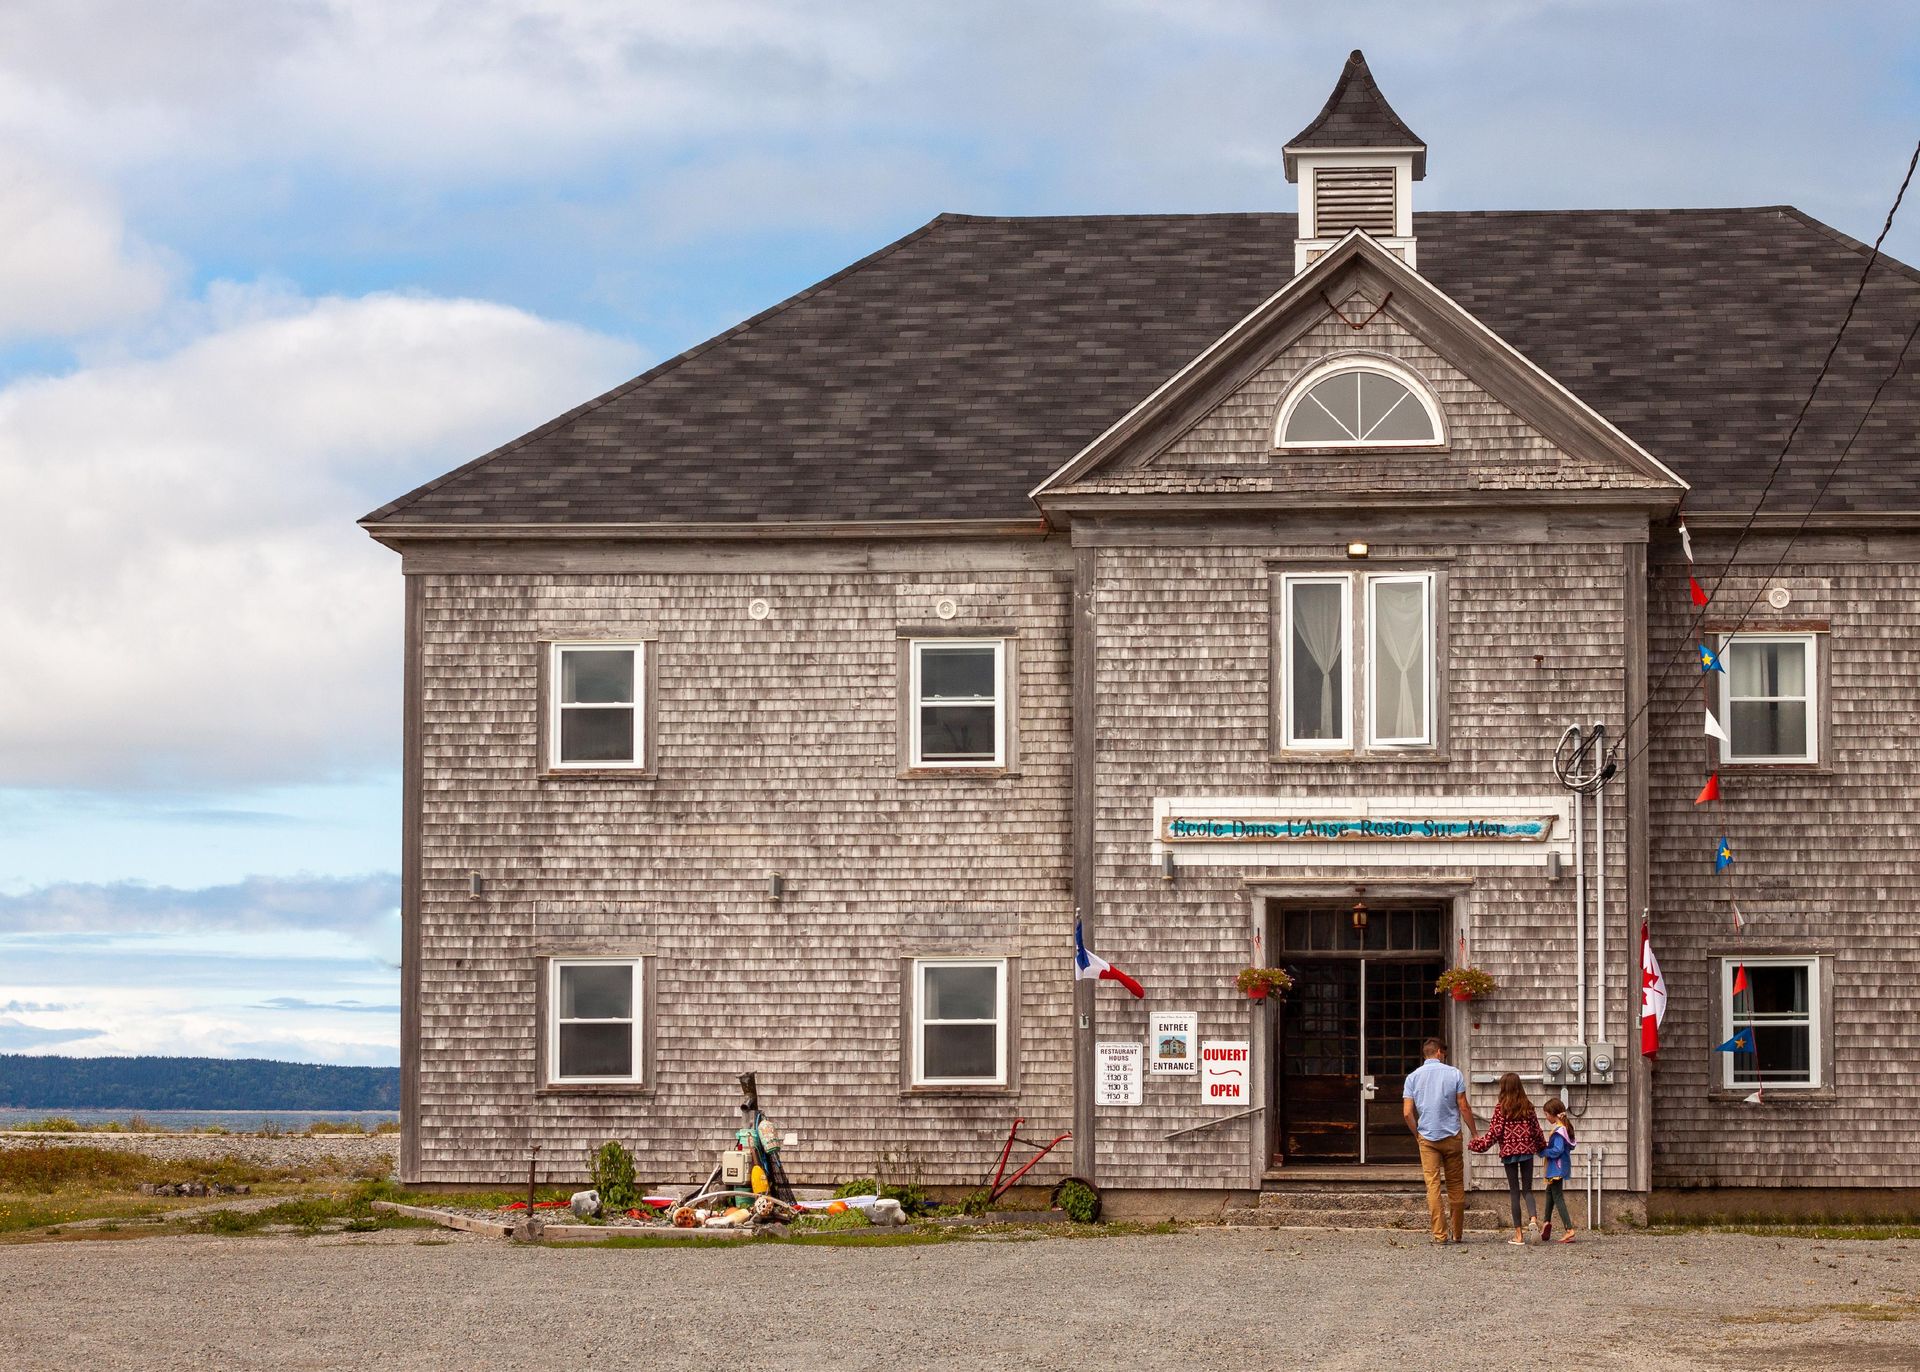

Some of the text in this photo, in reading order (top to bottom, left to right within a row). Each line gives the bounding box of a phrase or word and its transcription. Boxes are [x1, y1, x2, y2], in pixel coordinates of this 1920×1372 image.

[1173, 816, 1505, 838] École Dans L'Anse Resto Sur Mer
[1158, 1020, 1189, 1032] ENTRÉE
[1203, 1048, 1249, 1062] OUVERT
[1153, 1062, 1195, 1071] ENTRANCE
[1210, 1083, 1240, 1097] OPEN
